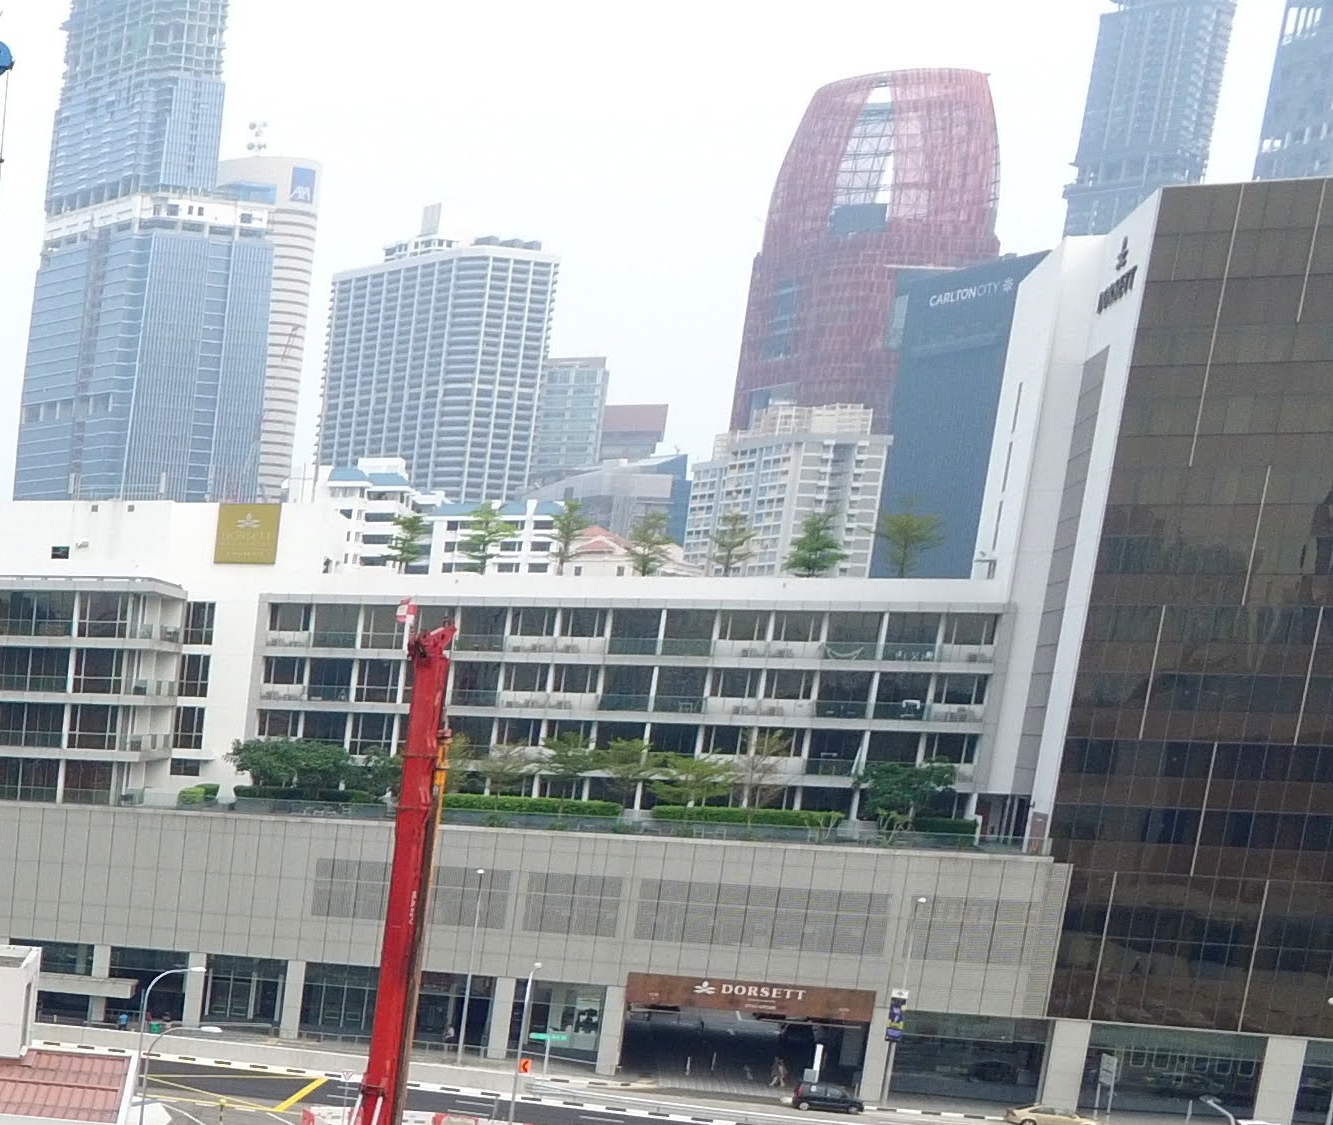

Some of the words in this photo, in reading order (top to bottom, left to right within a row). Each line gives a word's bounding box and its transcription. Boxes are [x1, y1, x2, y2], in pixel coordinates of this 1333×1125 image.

[929, 287, 976, 306] CARLTON
[977, 281, 1000, 296] CITY
[721, 983, 807, 1001] DORSETT
